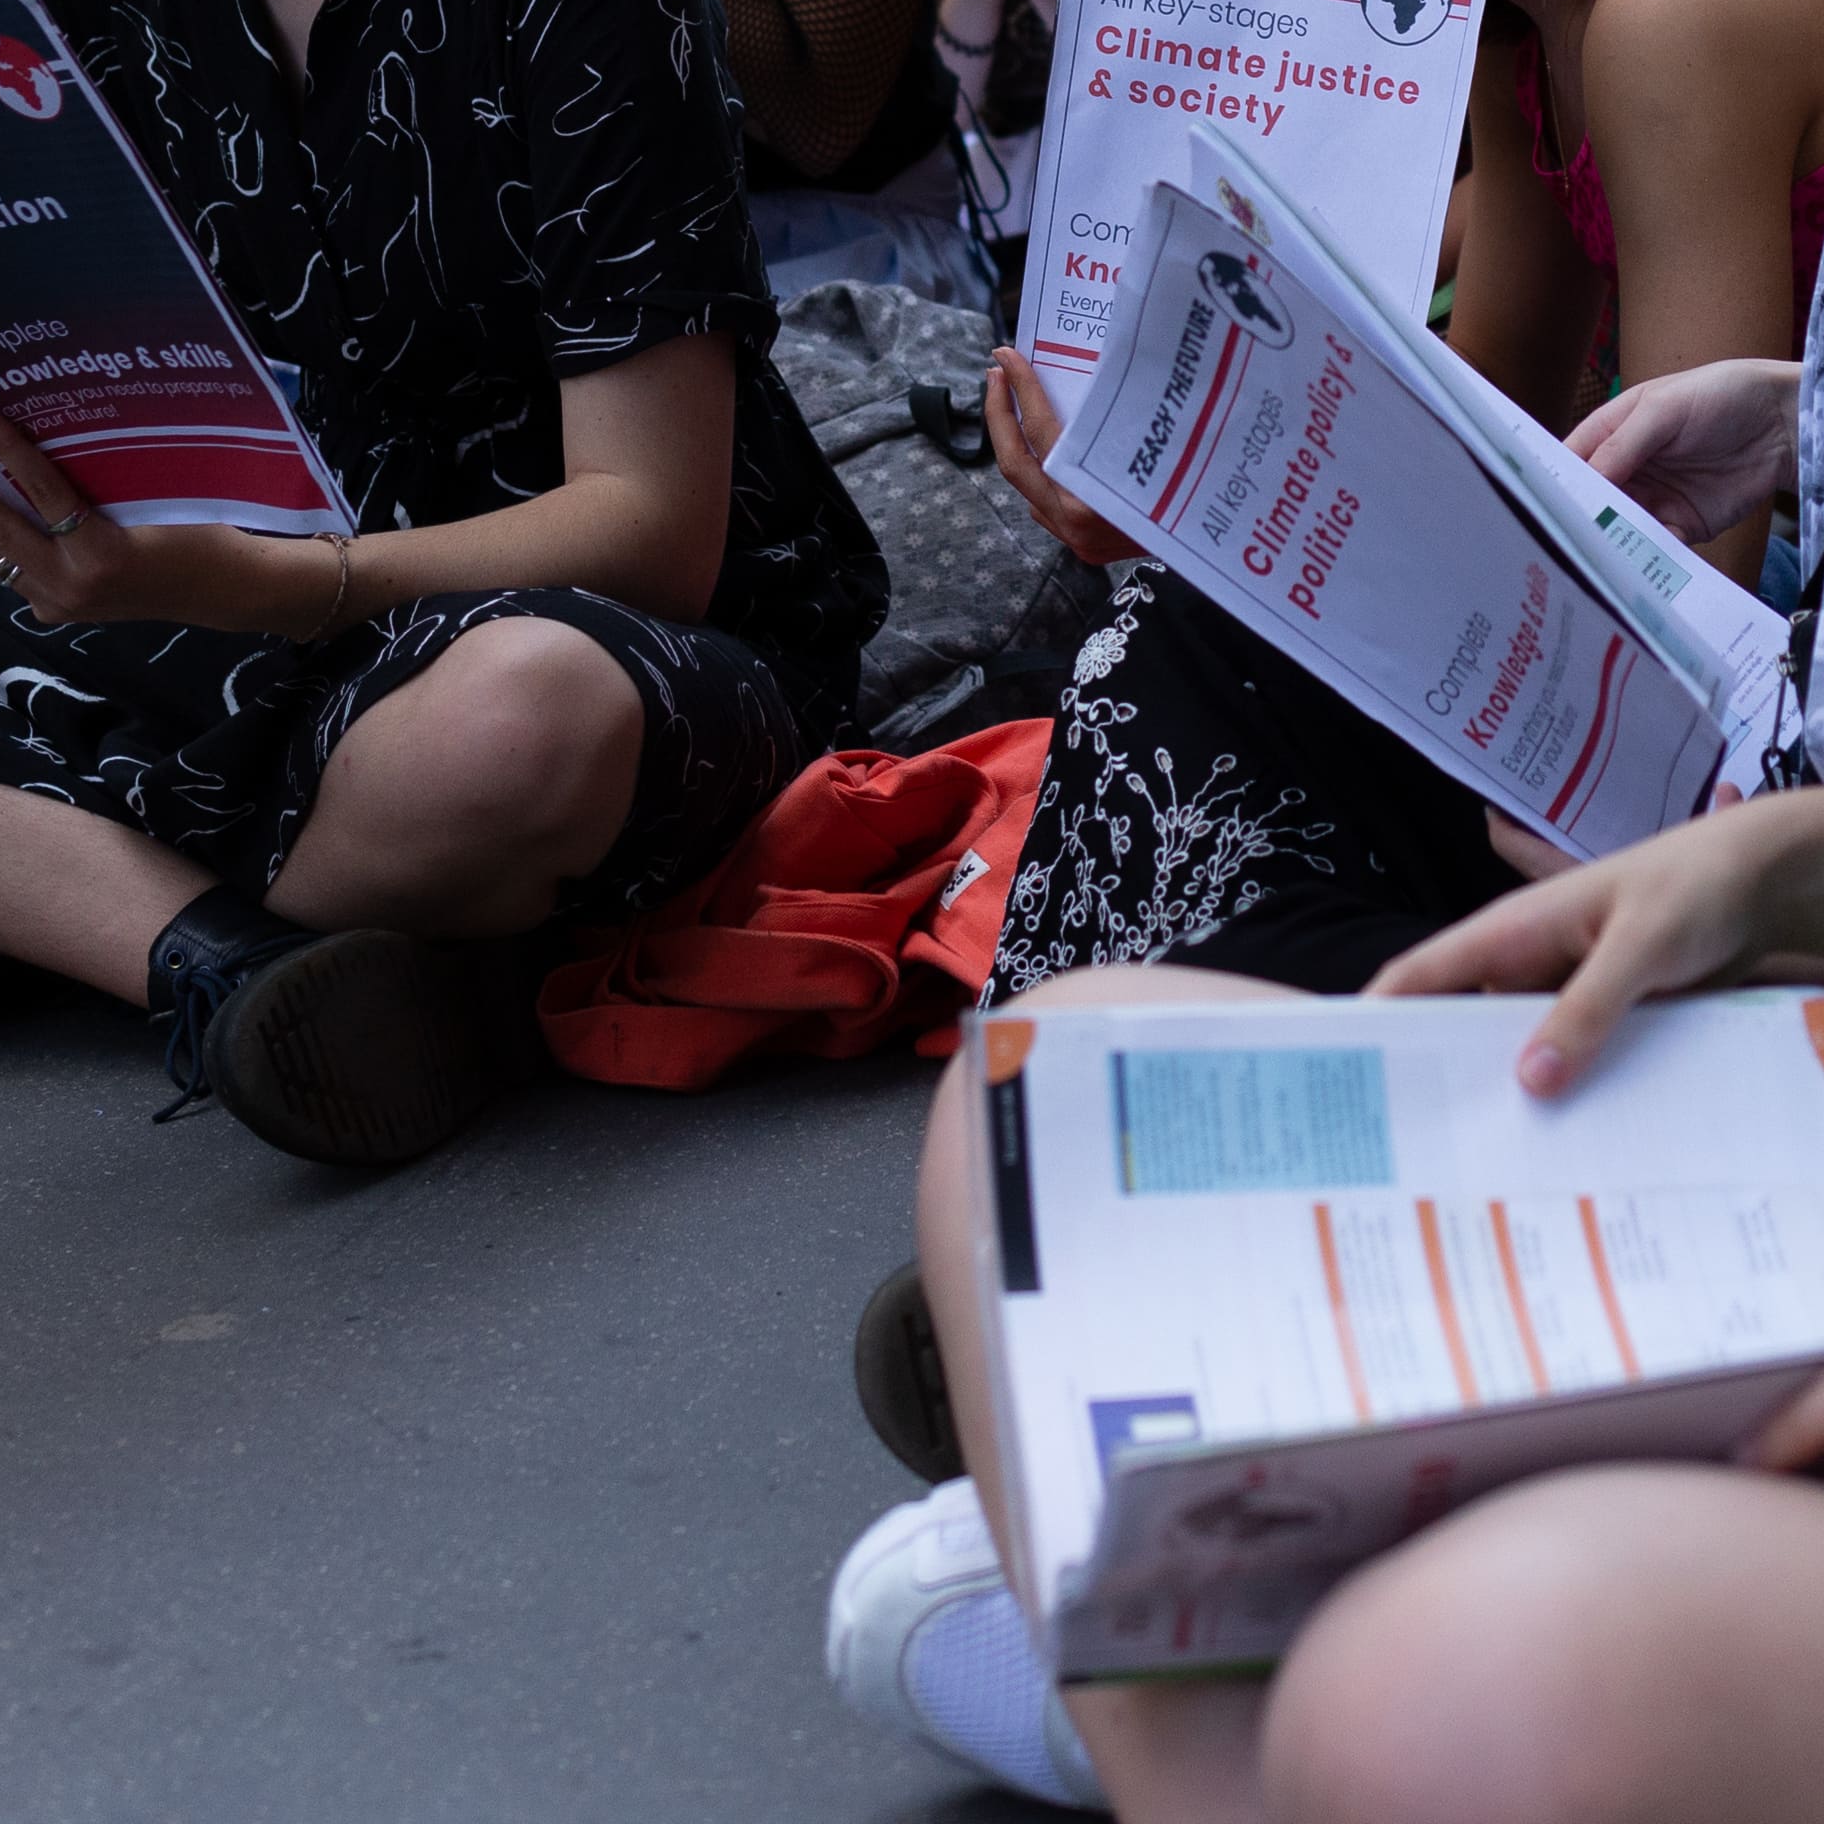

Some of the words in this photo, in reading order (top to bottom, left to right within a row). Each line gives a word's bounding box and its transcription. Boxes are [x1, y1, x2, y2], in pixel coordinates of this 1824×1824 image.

[1088, 69, 1113, 99] &
[1129, 80, 1285, 136] society
[1096, 25, 1266, 78] Climate
[1274, 51, 1420, 105] justice
[1056, 314, 1083, 333] for
[1086, 322, 1108, 341] yo
[1060, 290, 1114, 319] Everyt
[1174, 298, 1216, 375] FUTURE
[135, 346, 160, 369] &
[160, 342, 234, 369] skills
[1325, 333, 1354, 366] &
[3, 387, 75, 417] erything
[75, 384, 106, 404] you
[107, 381, 146, 397] need
[146, 380, 165, 395] to
[165, 380, 224, 398] prepare
[226, 383, 253, 399] you
[28, 411, 64, 435] your
[1164, 367, 1199, 410] THE
[1305, 359, 1356, 460] policy
[1128, 403, 1177, 488] TEACH
[1201, 494, 1231, 547] All
[1223, 389, 1285, 512] key-stages
[1243, 447, 1321, 577] Climate
[1287, 488, 1361, 621] politics
[1426, 611, 1492, 716] Complete
[1463, 621, 1544, 750] Knowledge
[1521, 599, 1544, 629] &
